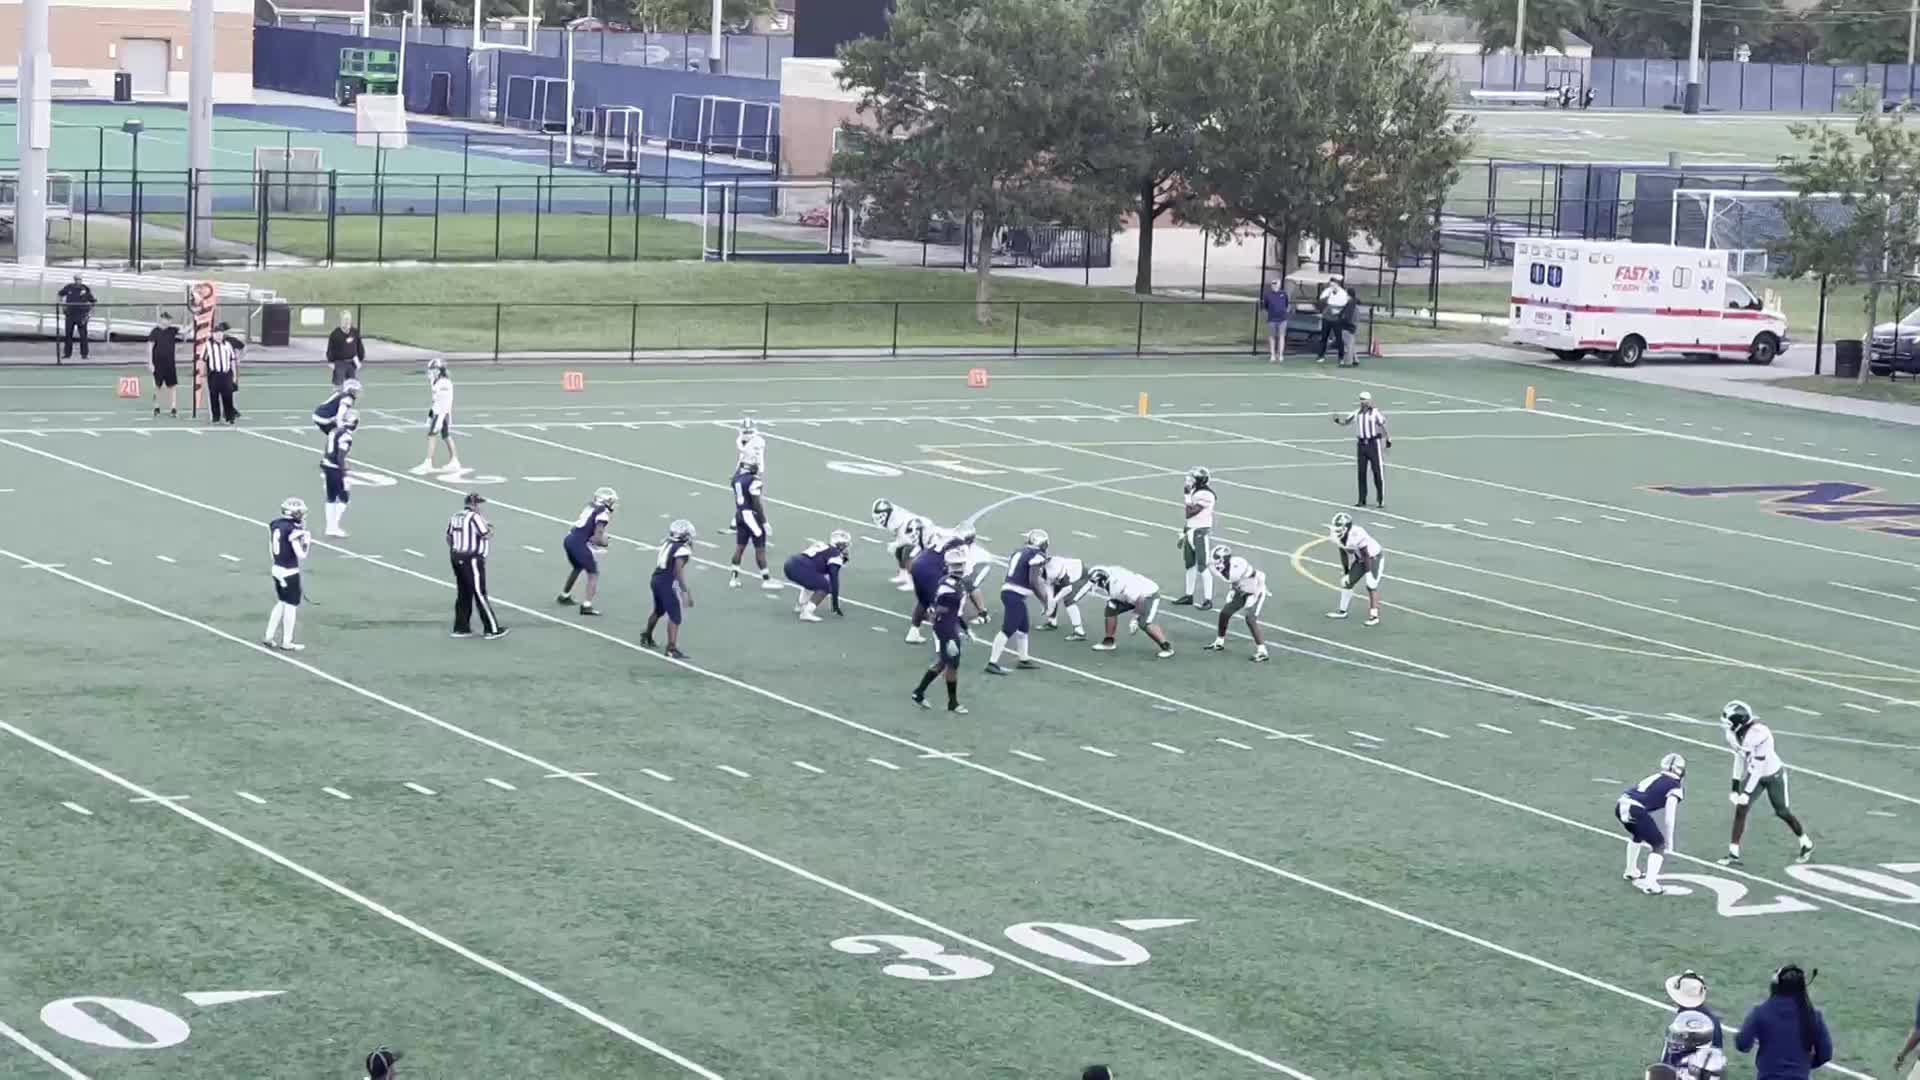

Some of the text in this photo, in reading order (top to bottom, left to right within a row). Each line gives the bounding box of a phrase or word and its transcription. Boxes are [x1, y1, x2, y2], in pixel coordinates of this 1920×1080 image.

[121, 380, 138, 394] 20
[1632, 863, 1920, 917] 20
[829, 921, 1151, 981] 30
